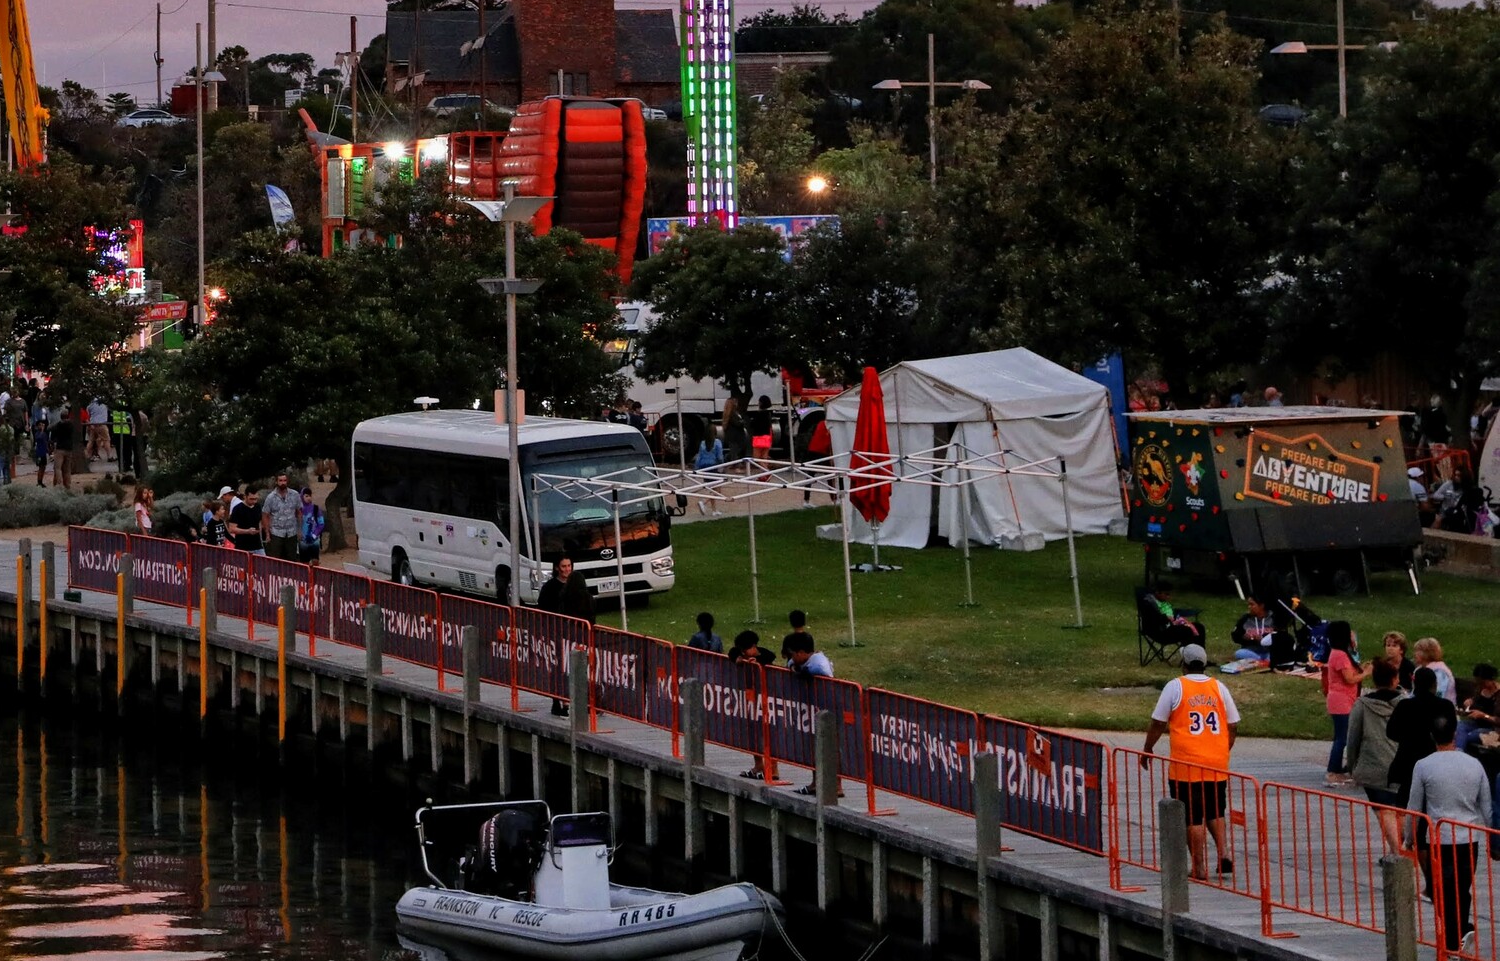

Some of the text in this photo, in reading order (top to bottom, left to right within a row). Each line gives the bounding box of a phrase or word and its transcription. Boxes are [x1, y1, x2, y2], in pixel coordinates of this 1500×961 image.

[1281, 448, 1347, 475] PREPARE FOR
[1253, 455, 1371, 504] ADVENTURE
[1265, 480, 1309, 502] PREPARE
[1185, 496, 1205, 507] Scouts
[1189, 711, 1220, 735] 34
[488, 817, 498, 873] MERCURY
[433, 896, 483, 916] FRANKSTON
[488, 905, 505, 920] YC
[512, 909, 547, 927] RESCUE
